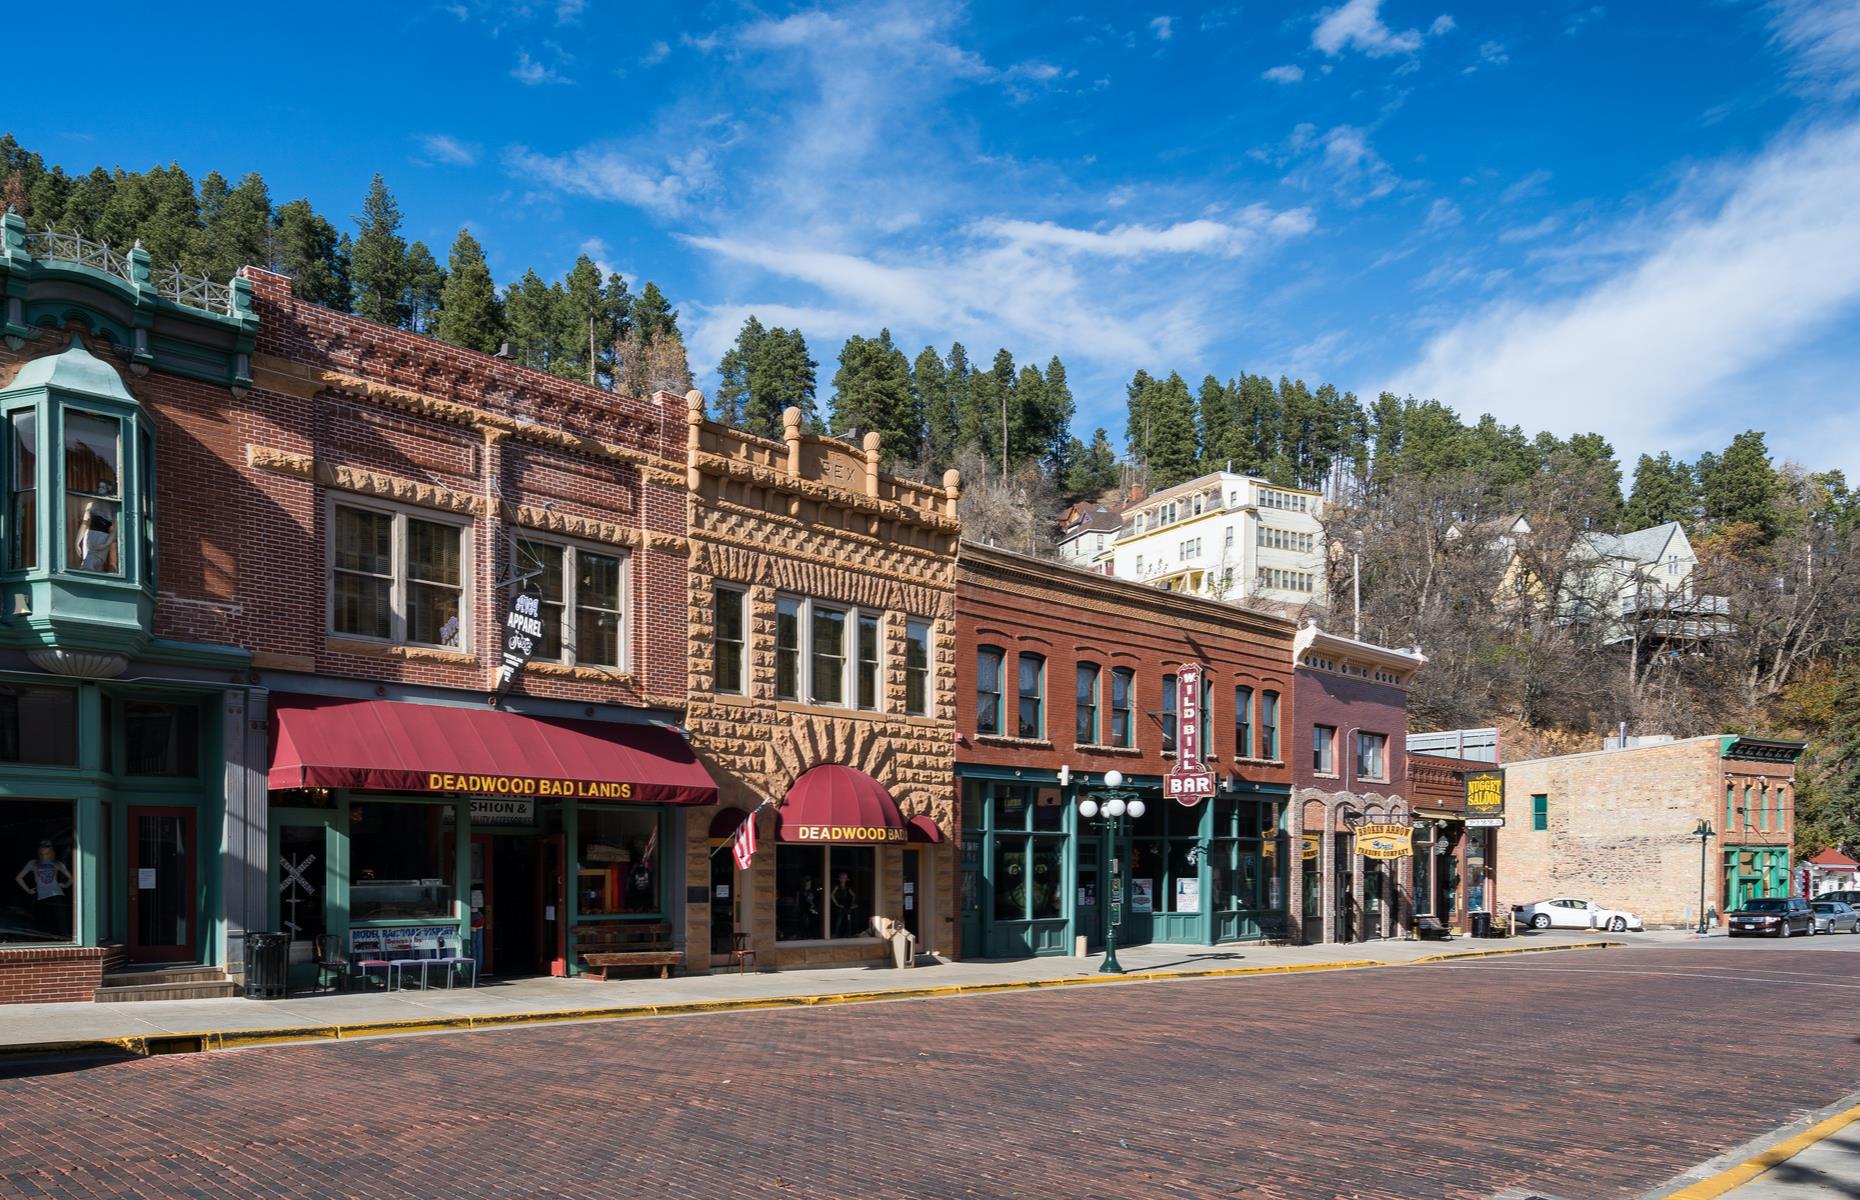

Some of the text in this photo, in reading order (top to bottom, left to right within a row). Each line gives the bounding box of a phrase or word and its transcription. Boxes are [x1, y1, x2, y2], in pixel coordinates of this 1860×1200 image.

[507, 611, 542, 638] APPAREL
[1183, 672, 1196, 770] WILD BILL
[429, 773, 632, 798] DEADWOOD BAD LANDS
[1170, 777, 1210, 793] BAR
[1468, 780, 1501, 796] NUGGET
[1468, 790, 1501, 805] SALOON
[470, 802, 514, 813] SHION
[799, 827, 887, 840] DEADWOOD
[1358, 826, 1411, 836] BROKEN ARROW
[1358, 848, 1409, 857] TRADING COMPANY
